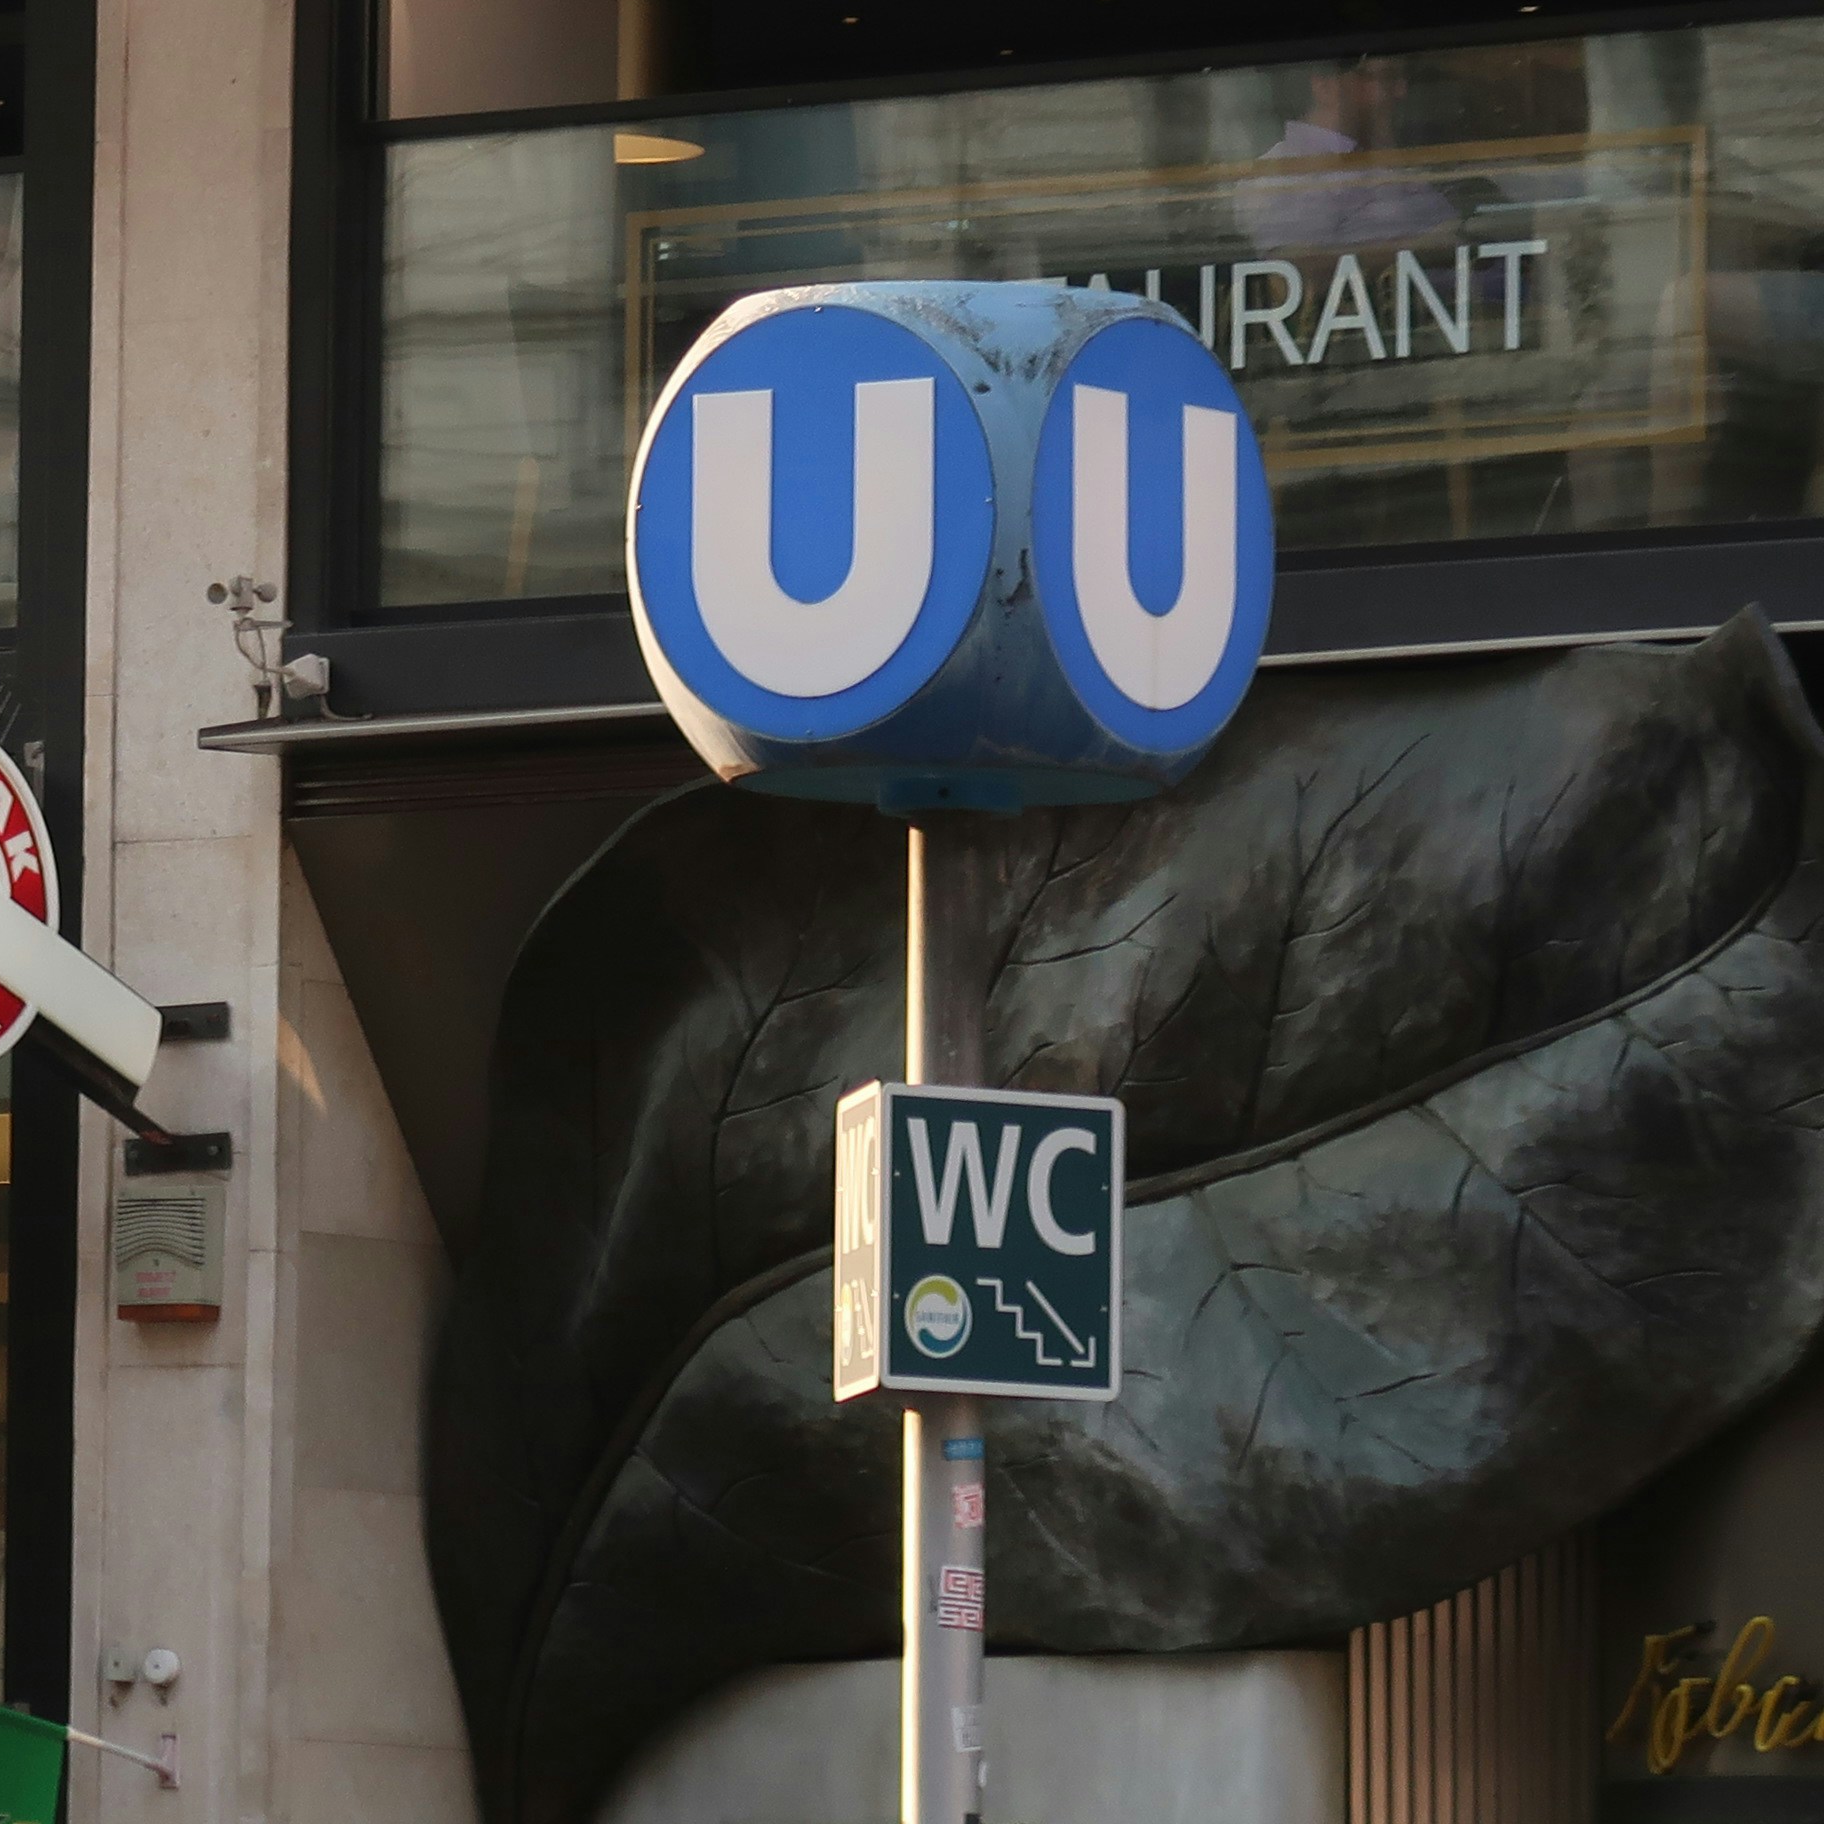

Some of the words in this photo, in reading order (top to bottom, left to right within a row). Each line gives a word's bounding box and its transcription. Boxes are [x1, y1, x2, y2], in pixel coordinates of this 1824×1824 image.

[692, 377, 934, 698] U
[1073, 384, 1237, 710] U
[906, 1117, 1097, 1256] WC
